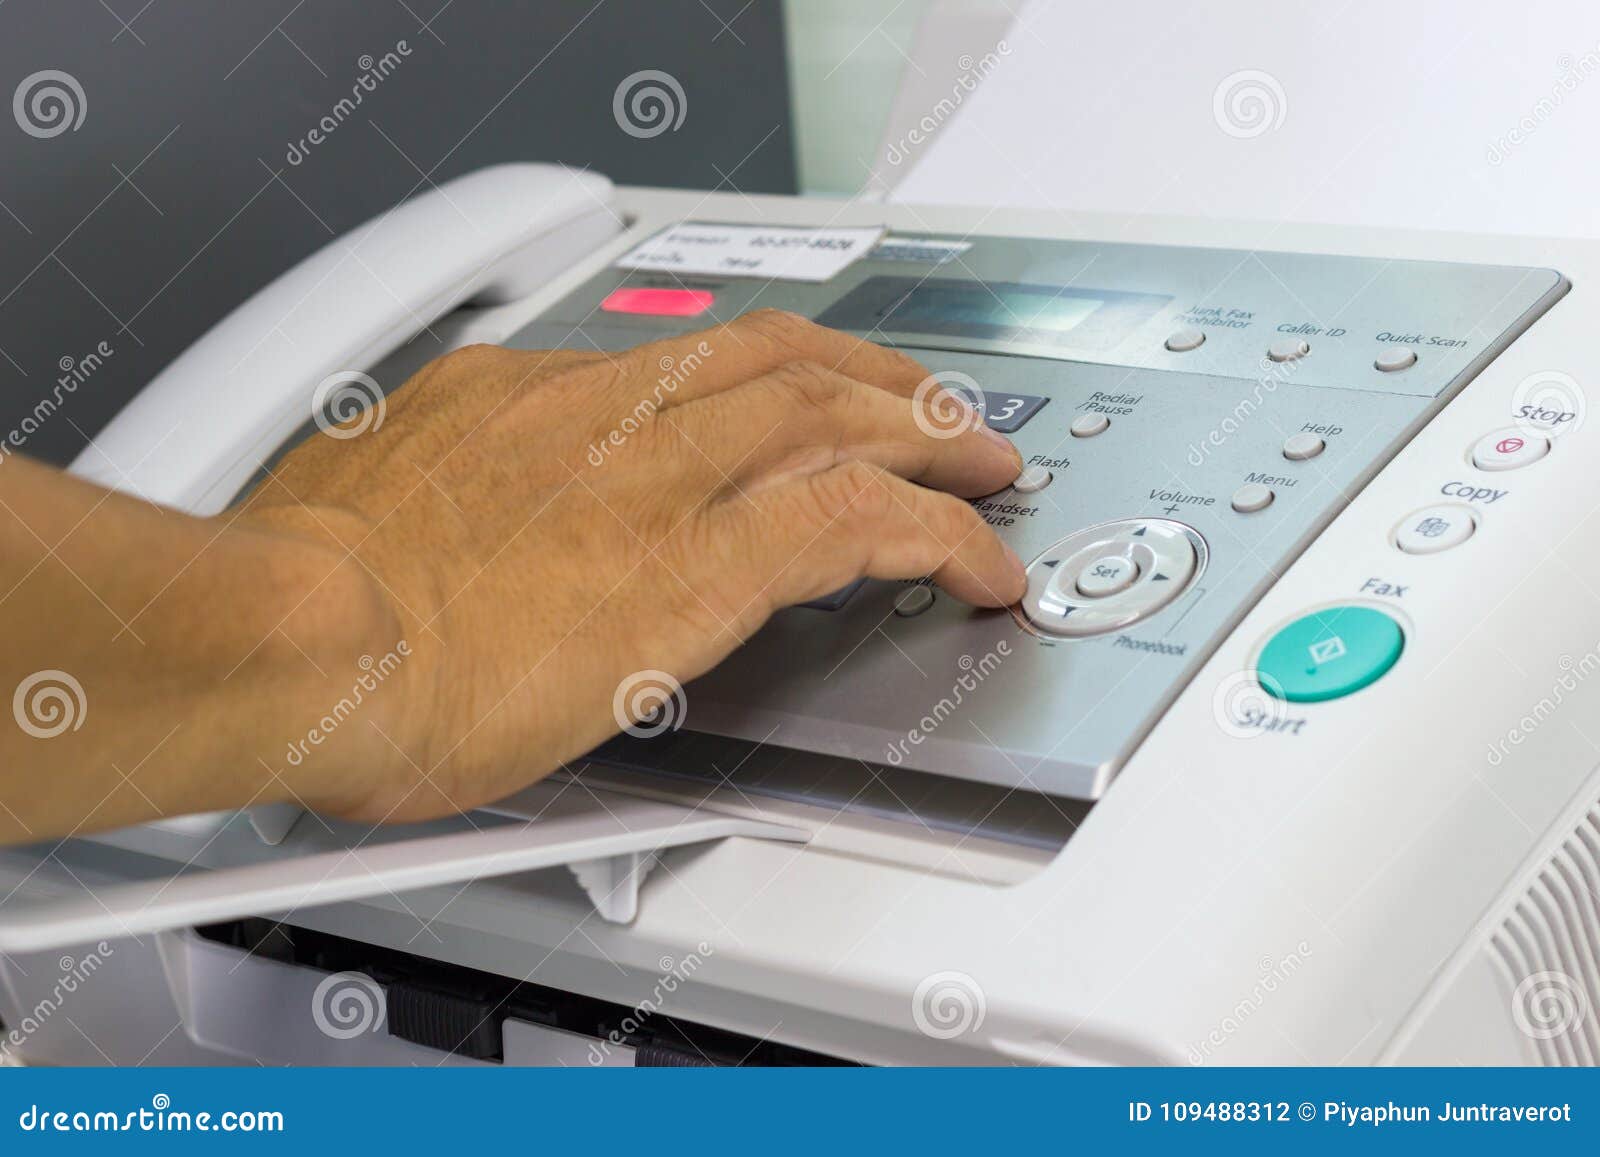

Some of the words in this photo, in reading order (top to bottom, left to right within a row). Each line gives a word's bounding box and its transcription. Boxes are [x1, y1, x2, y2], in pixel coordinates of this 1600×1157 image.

[1185, 305, 1224, 317] Junk
[1226, 308, 1256, 319] Fax
[1277, 322, 1323, 336] Caller
[1326, 328, 1346, 337] ID
[1375, 332, 1424, 344] Quick
[1426, 336, 1468, 348] Scan
[1089, 391, 1143, 406] Redial
[989, 399, 1024, 420] 3
[1076, 401, 1133, 416] /Pause
[1512, 404, 1576, 424] Stop
[1301, 422, 1343, 437] Help
[1028, 455, 1071, 469] Flash
[1244, 472, 1298, 488] Menu
[1150, 489, 1215, 506] Volume
[1440, 481, 1508, 504] Copy
[1091, 565, 1119, 579] Set
[1360, 578, 1410, 598] Fax
[1112, 635, 1187, 656] Phonebook
[1237, 707, 1307, 735] Start
